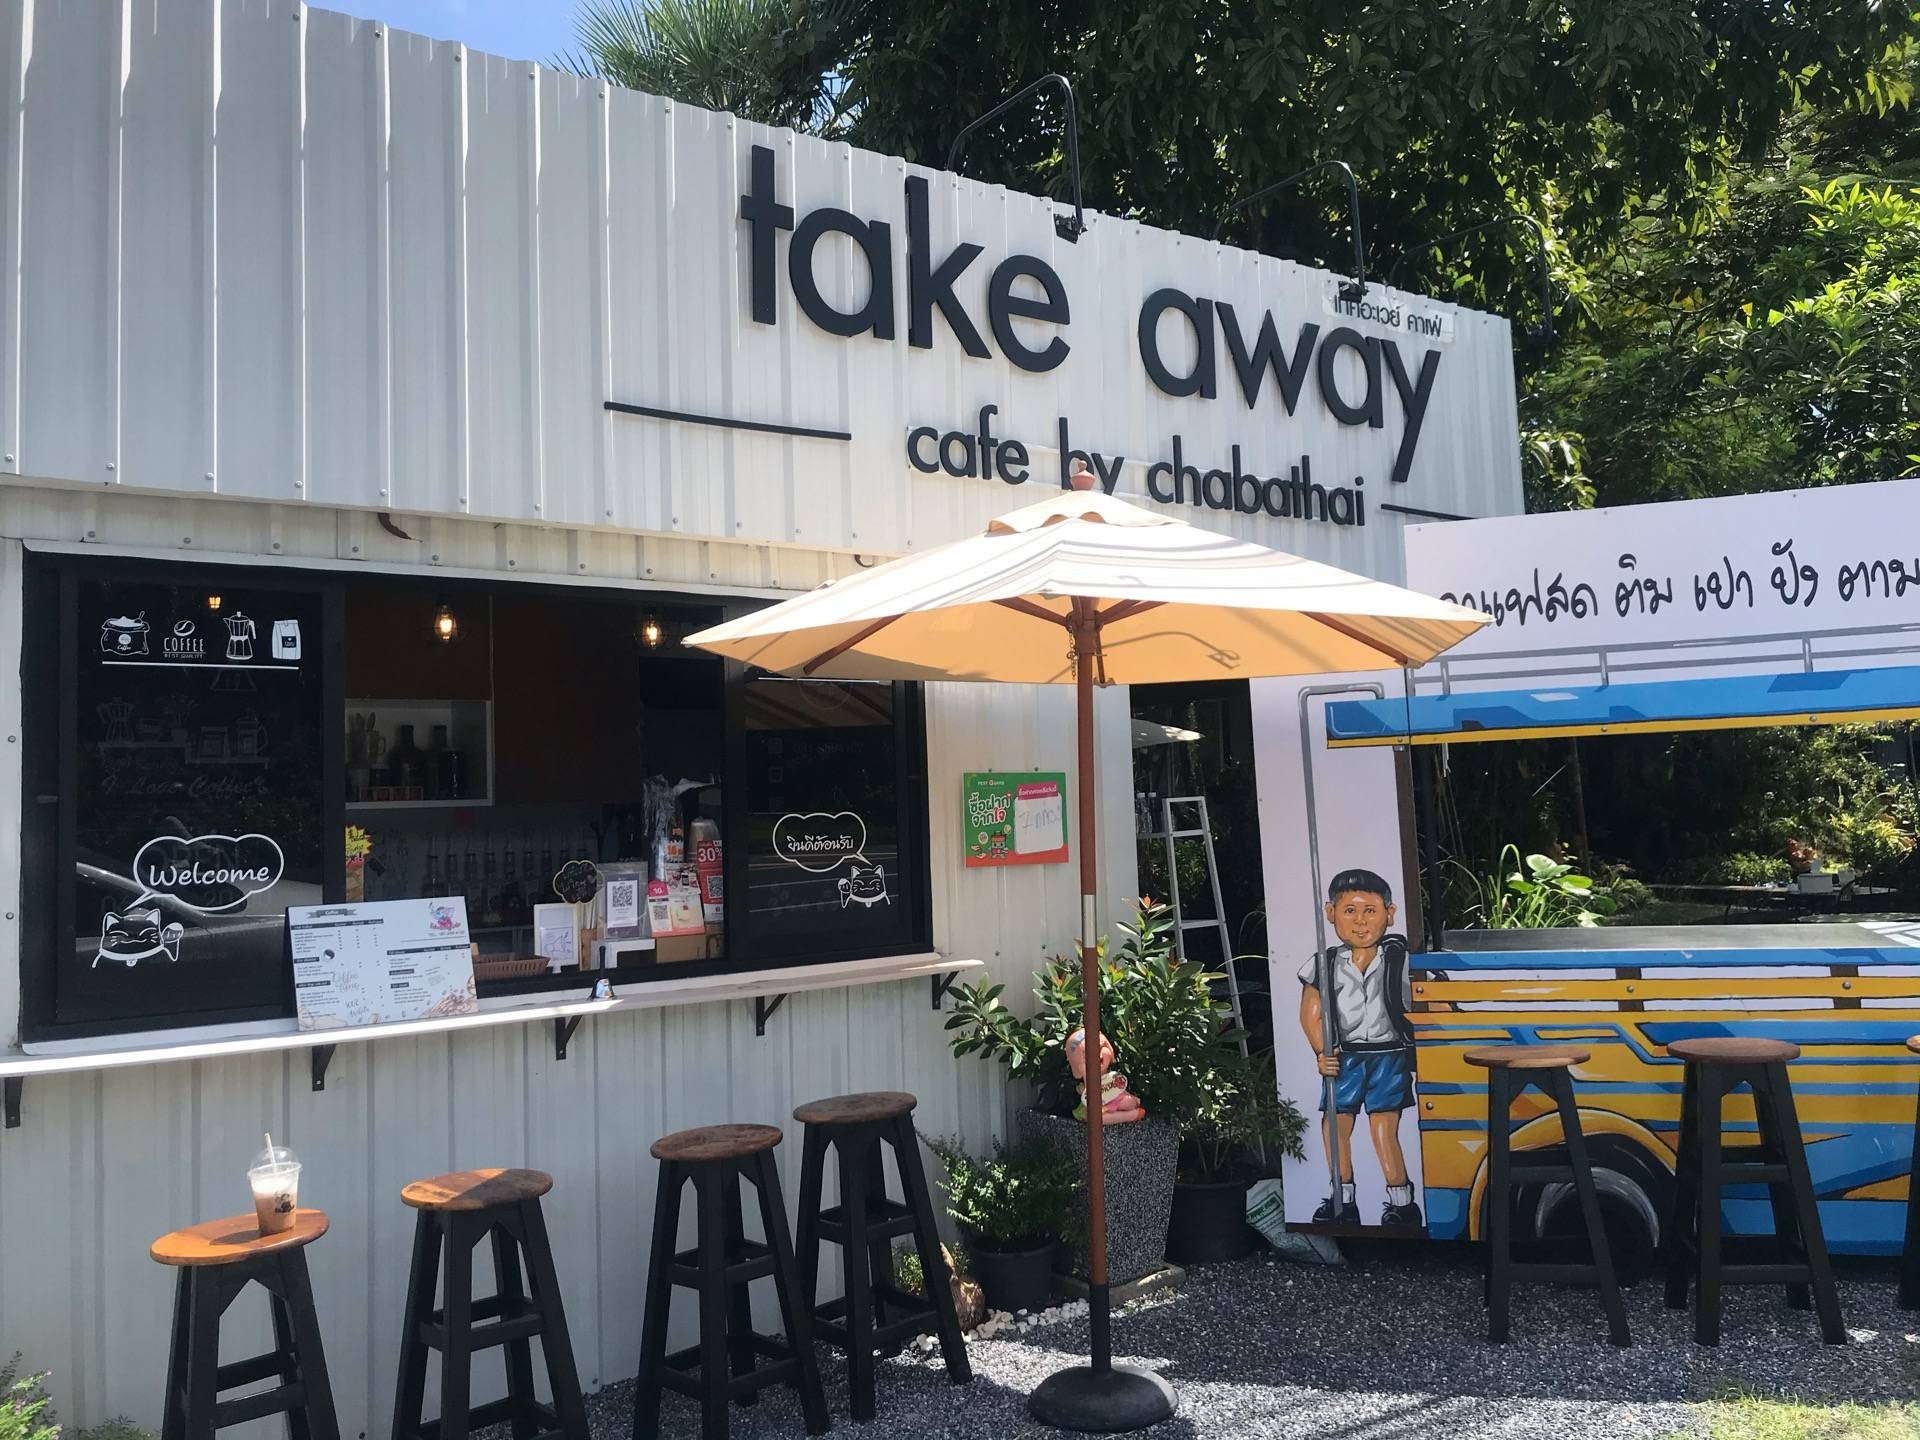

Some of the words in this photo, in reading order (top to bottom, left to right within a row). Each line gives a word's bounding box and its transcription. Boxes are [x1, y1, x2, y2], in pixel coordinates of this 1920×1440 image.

[740, 144, 1071, 373] take
[1137, 288, 1441, 483] away
[907, 404, 1030, 486] cafe
[1059, 417, 1125, 496] by
[1147, 435, 1365, 527] chabathai
[1771, 538, 1819, 607] ปัง
[164, 637, 204, 652] COFFEE
[786, 834, 854, 852] ยินดีต้อนรับ
[149, 861, 270, 887] Welcome
